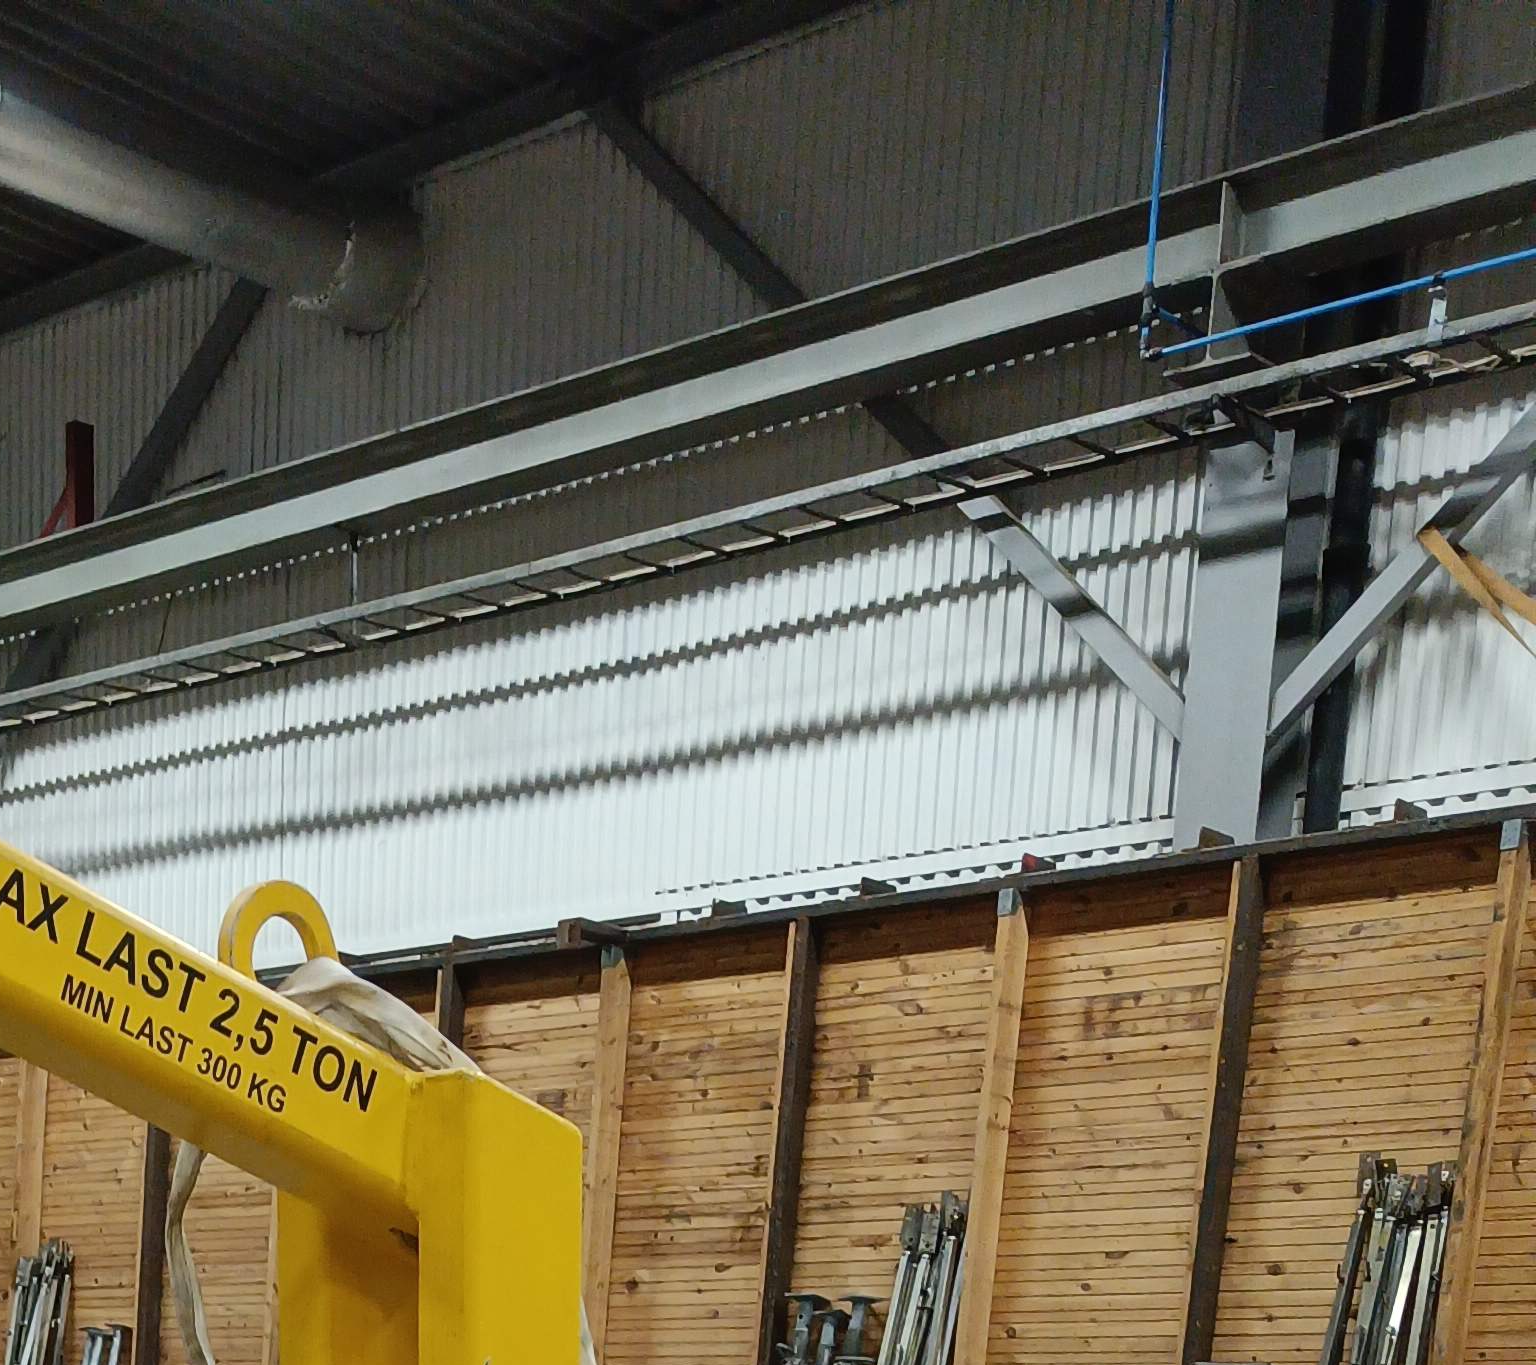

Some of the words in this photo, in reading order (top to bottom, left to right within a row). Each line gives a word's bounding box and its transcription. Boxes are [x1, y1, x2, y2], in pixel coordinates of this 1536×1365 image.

[60, 974, 115, 1024] MIN
[119, 1005, 194, 1063] LAST
[197, 1047, 242, 1090] 300
[247, 1072, 287, 1113] KG
[75, 909, 207, 1013] LAST
[210, 988, 279, 1056] 2,5
[291, 1024, 378, 1112] TON
